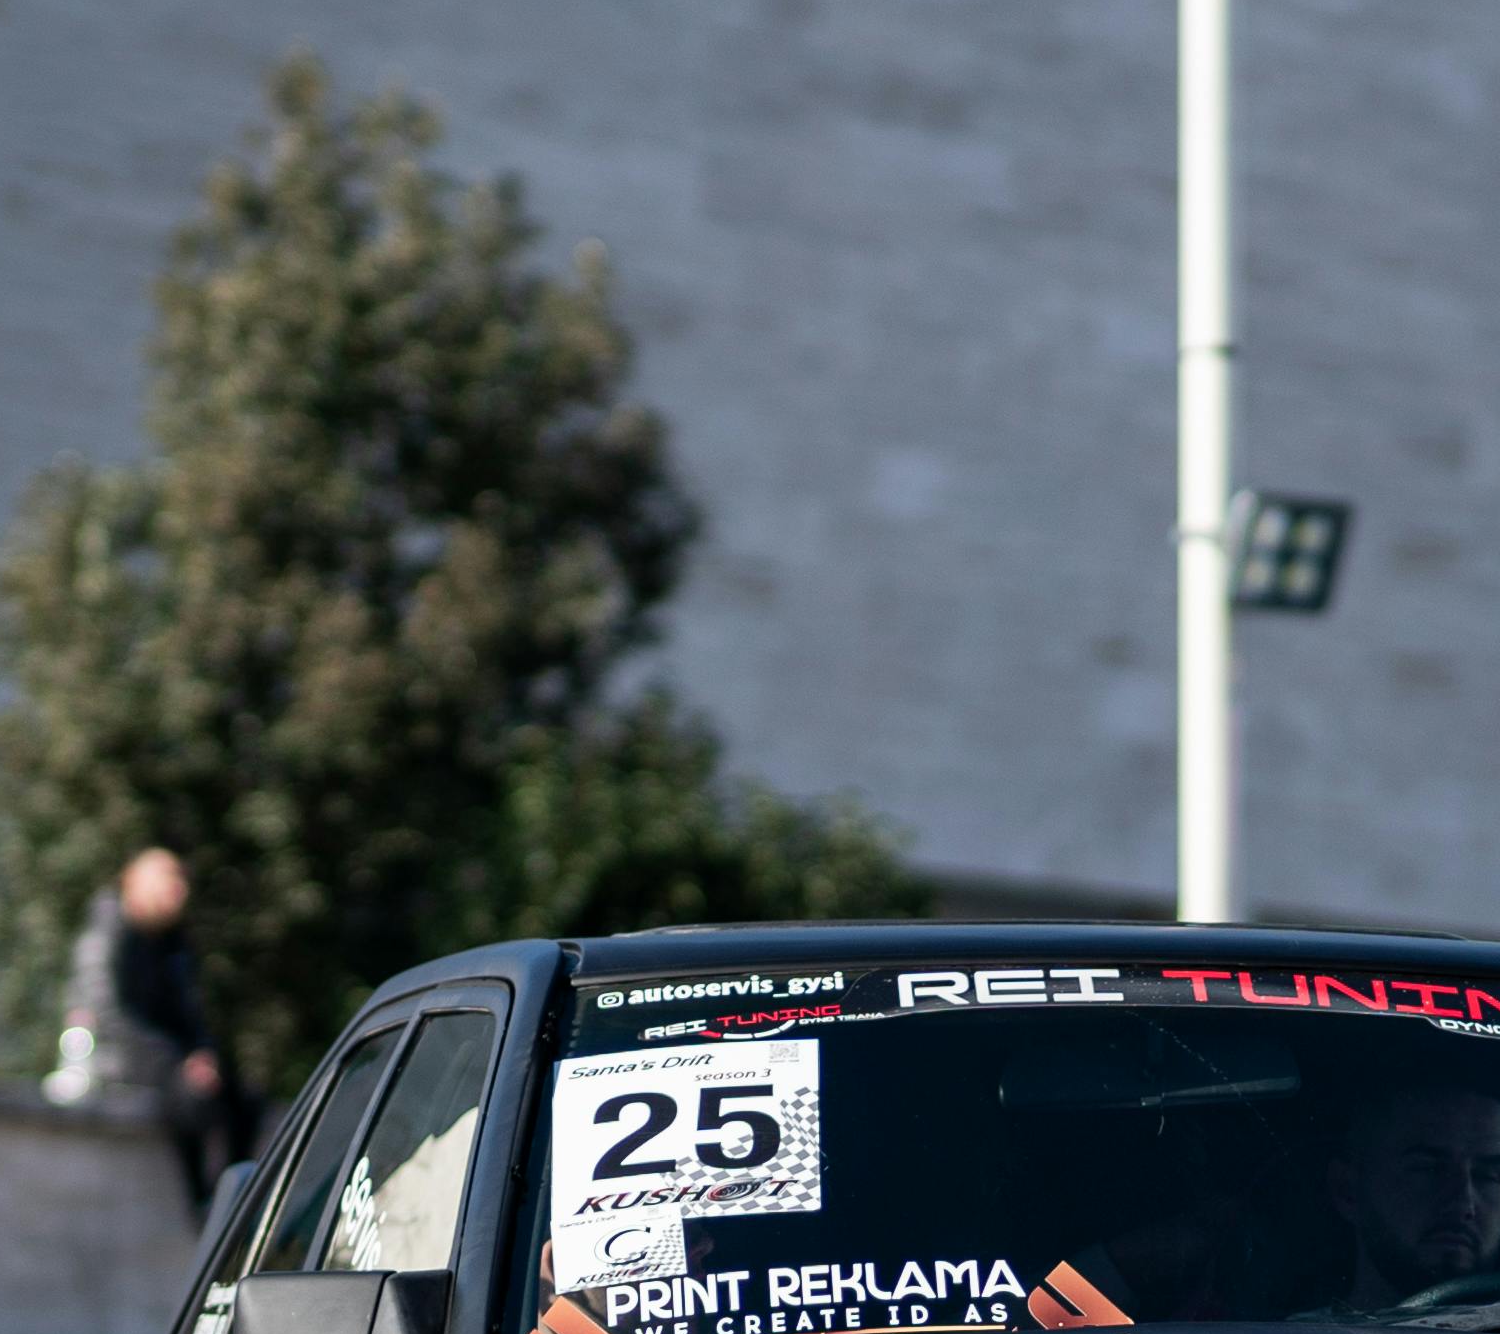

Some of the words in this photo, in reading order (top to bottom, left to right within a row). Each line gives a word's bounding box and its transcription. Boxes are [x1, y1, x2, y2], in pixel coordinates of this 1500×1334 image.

[628, 971, 844, 1005] autoservis_gysi
[898, 968, 1124, 1008] REI
[644, 1019, 707, 1040] REI
[716, 1004, 841, 1026] TUNING
[569, 1059, 654, 1080] Santa's
[661, 1053, 716, 1069] Drift
[694, 1069, 757, 1082] season
[760, 1068, 772, 1079] 3
[592, 1084, 782, 1181] 25
[606, 1268, 751, 1327] PRINT
[768, 1259, 1026, 1308] REKLAMA
[888, 1304, 930, 1325] ID
[964, 1303, 1009, 1323] AS
